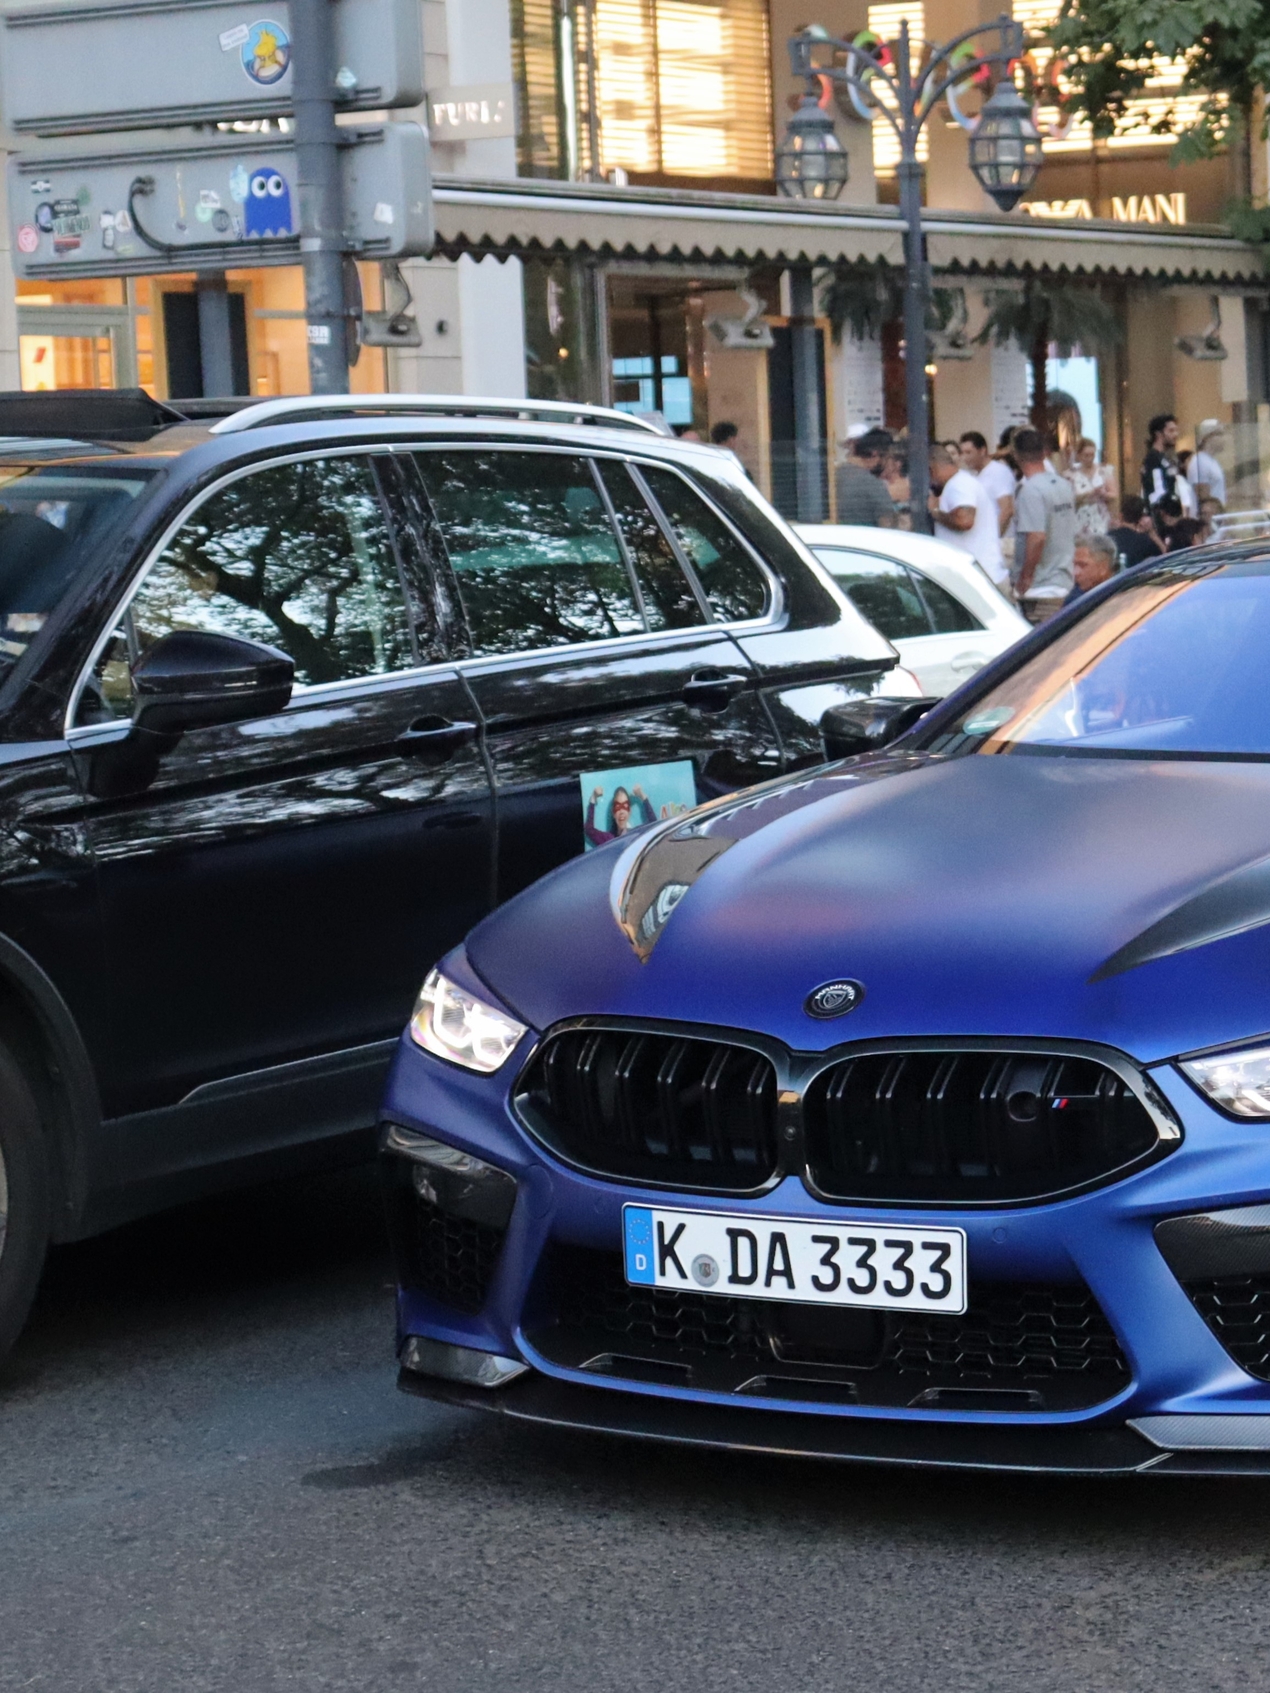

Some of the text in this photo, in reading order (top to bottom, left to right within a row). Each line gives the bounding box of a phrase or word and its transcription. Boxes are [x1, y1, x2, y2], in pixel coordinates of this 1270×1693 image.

[635, 1253, 647, 1270] D
[656, 1220, 952, 1300] K DA 3333
